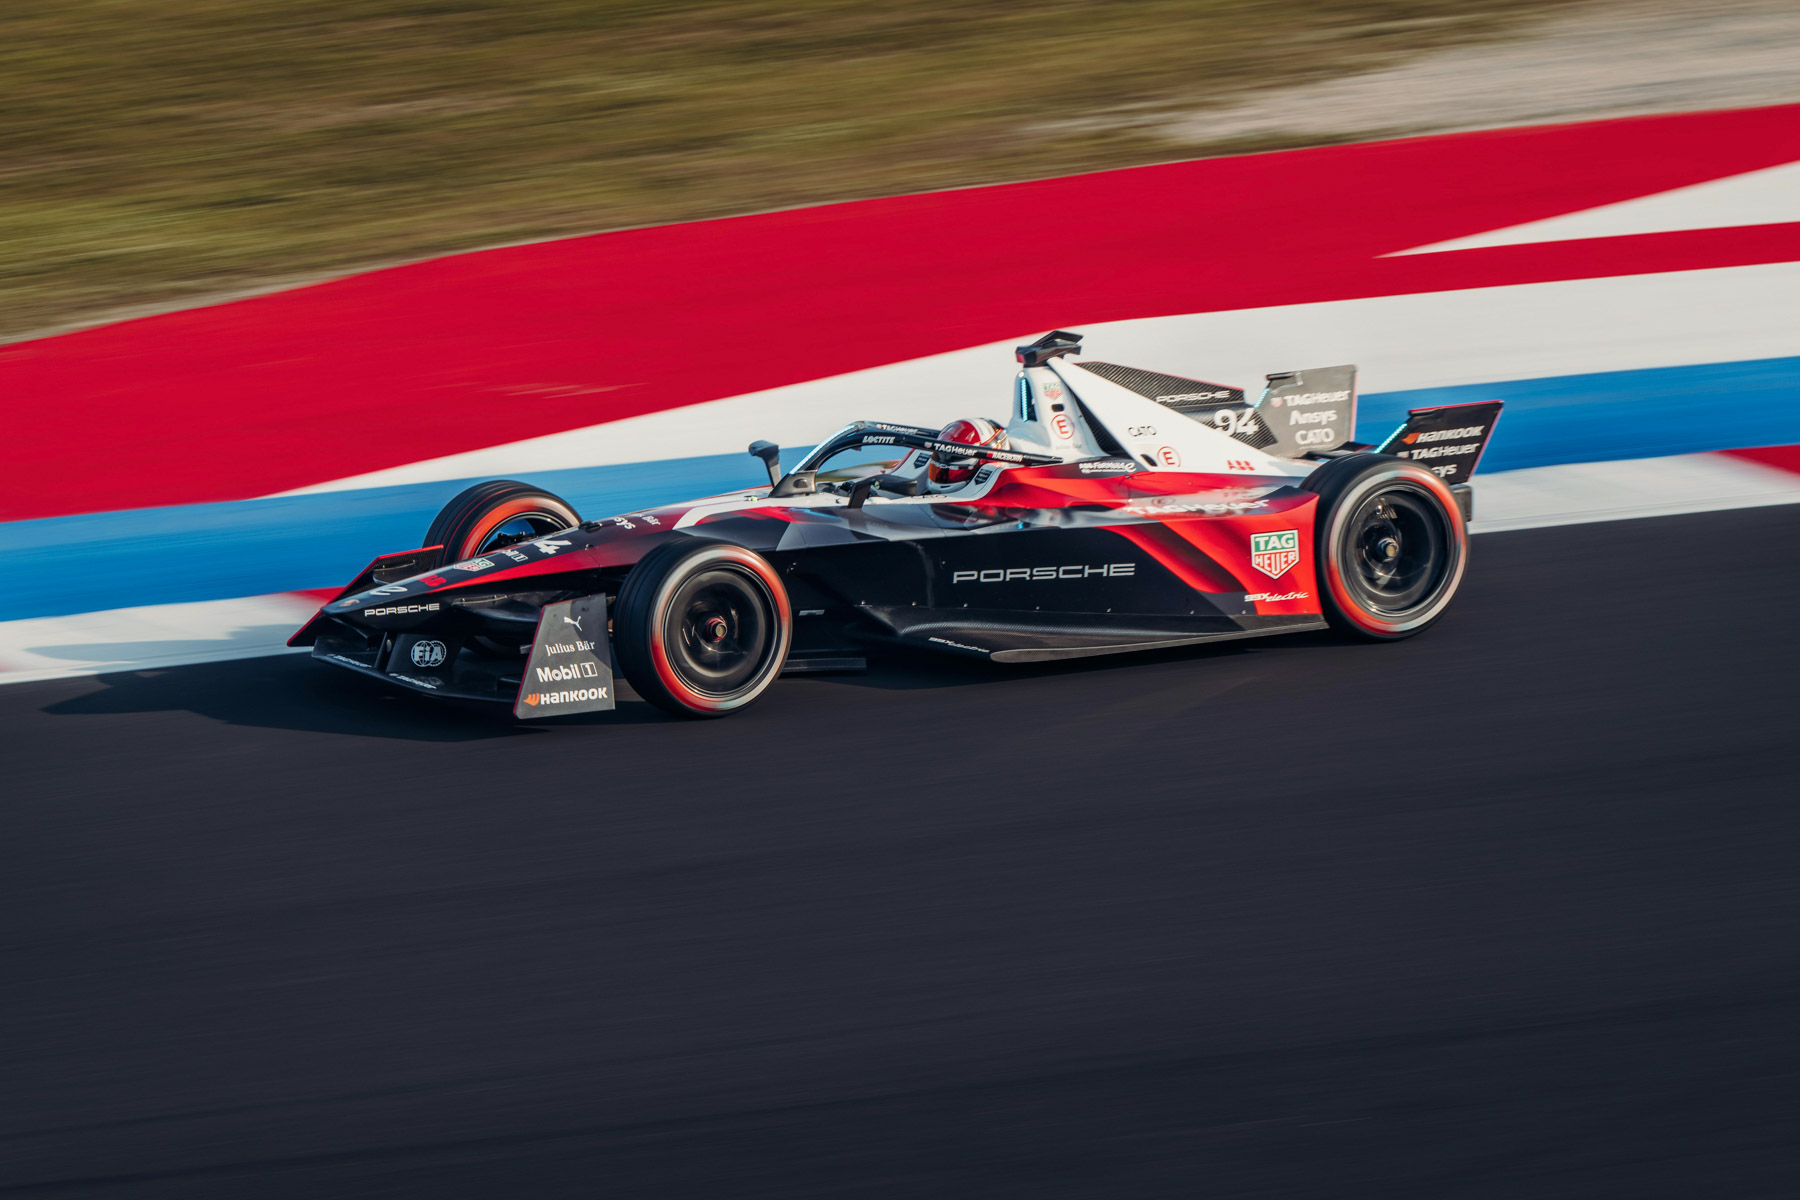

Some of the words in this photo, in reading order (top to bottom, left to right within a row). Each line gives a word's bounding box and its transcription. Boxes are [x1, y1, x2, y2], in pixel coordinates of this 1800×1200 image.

[1156, 390, 1230, 402] PORSCHE
[1214, 407, 1259, 437] 94
[1289, 410, 1337, 425] Ansys
[1056, 419, 1069, 434] E
[862, 436, 895, 444] LOCTITE
[1295, 428, 1335, 444] CATO
[1163, 451, 1175, 465] E
[1255, 534, 1294, 551] TAG
[1255, 551, 1296, 574] HEUER
[953, 563, 1136, 584] PORSCHE
[364, 602, 440, 617] PORSCHE
[545, 643, 575, 657] Julius
[576, 640, 596, 652] Bär
[536, 663, 581, 682] Mobil
